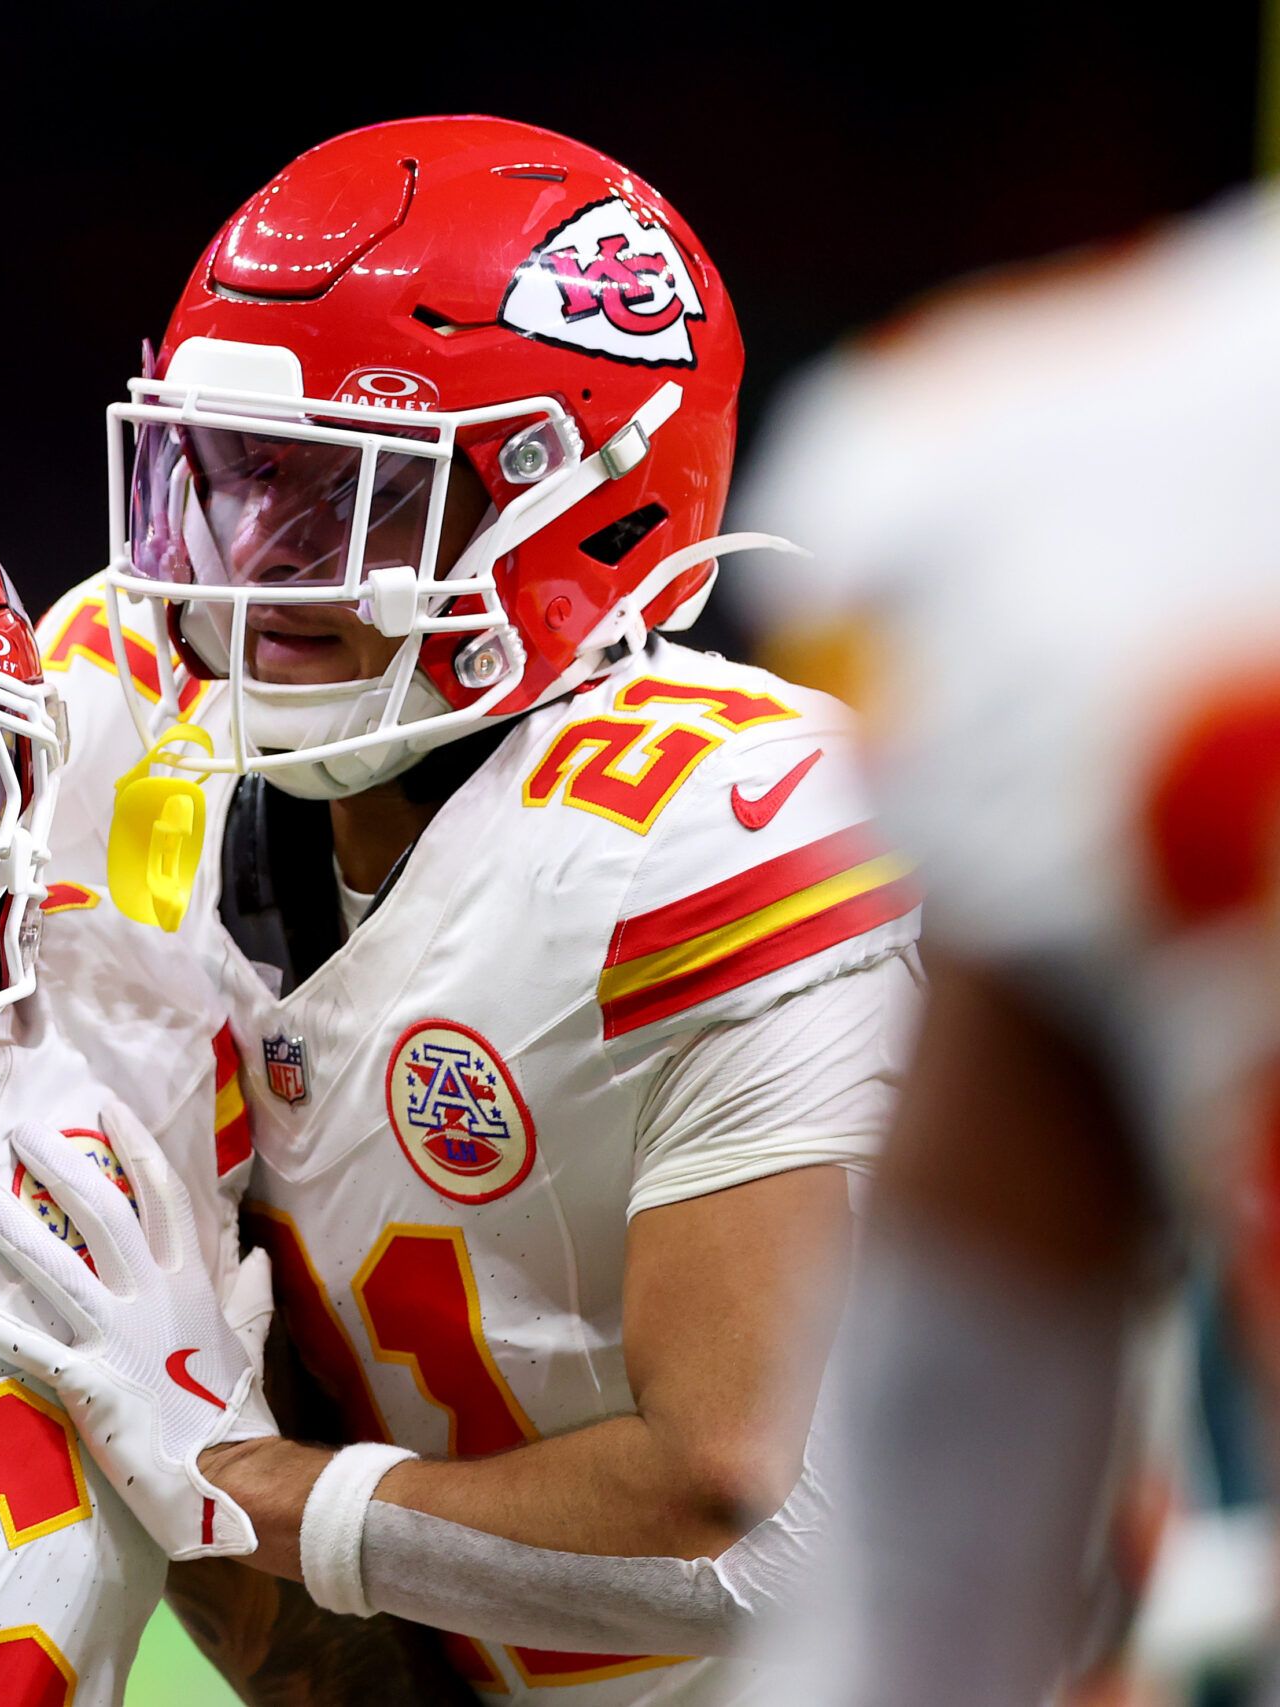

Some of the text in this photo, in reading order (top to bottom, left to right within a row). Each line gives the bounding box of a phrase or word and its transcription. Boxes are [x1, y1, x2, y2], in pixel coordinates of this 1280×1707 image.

[540, 232, 685, 337] KC
[341, 393, 432, 412] OAKLEY
[522, 674, 803, 837] 21
[444, 1138, 479, 1163] LH
